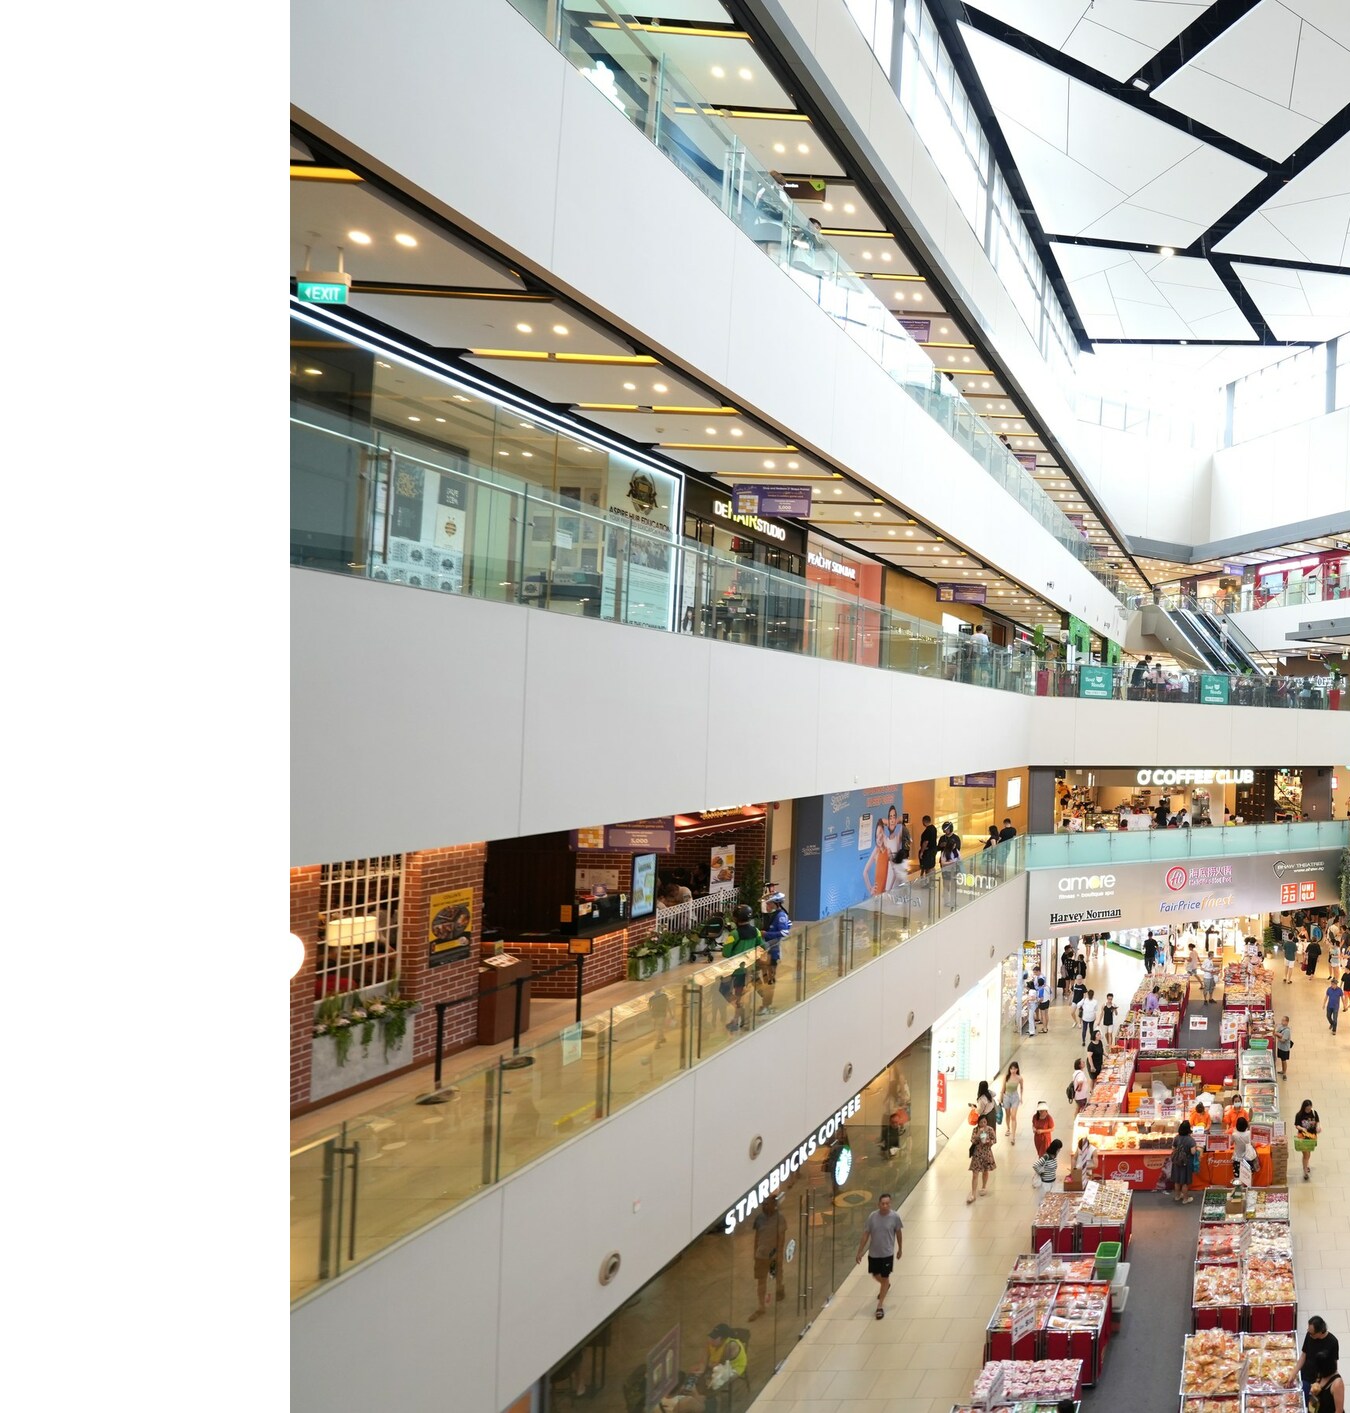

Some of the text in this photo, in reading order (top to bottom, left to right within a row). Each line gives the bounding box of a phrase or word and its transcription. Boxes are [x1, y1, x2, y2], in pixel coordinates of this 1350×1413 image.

[312, 286, 342, 300] EXIT
[609, 506, 628, 518] ASPIRE
[1152, 769, 1214, 785] COFFEE
[1215, 769, 1254, 784] CLUB
[1058, 874, 1116, 891] amore
[1302, 883, 1314, 892] UNI
[1160, 891, 1234, 912] FairPrice finest
[1050, 908, 1122, 922] Harvey Norman
[725, 1094, 861, 1235] STARBUCKS COFFEE
